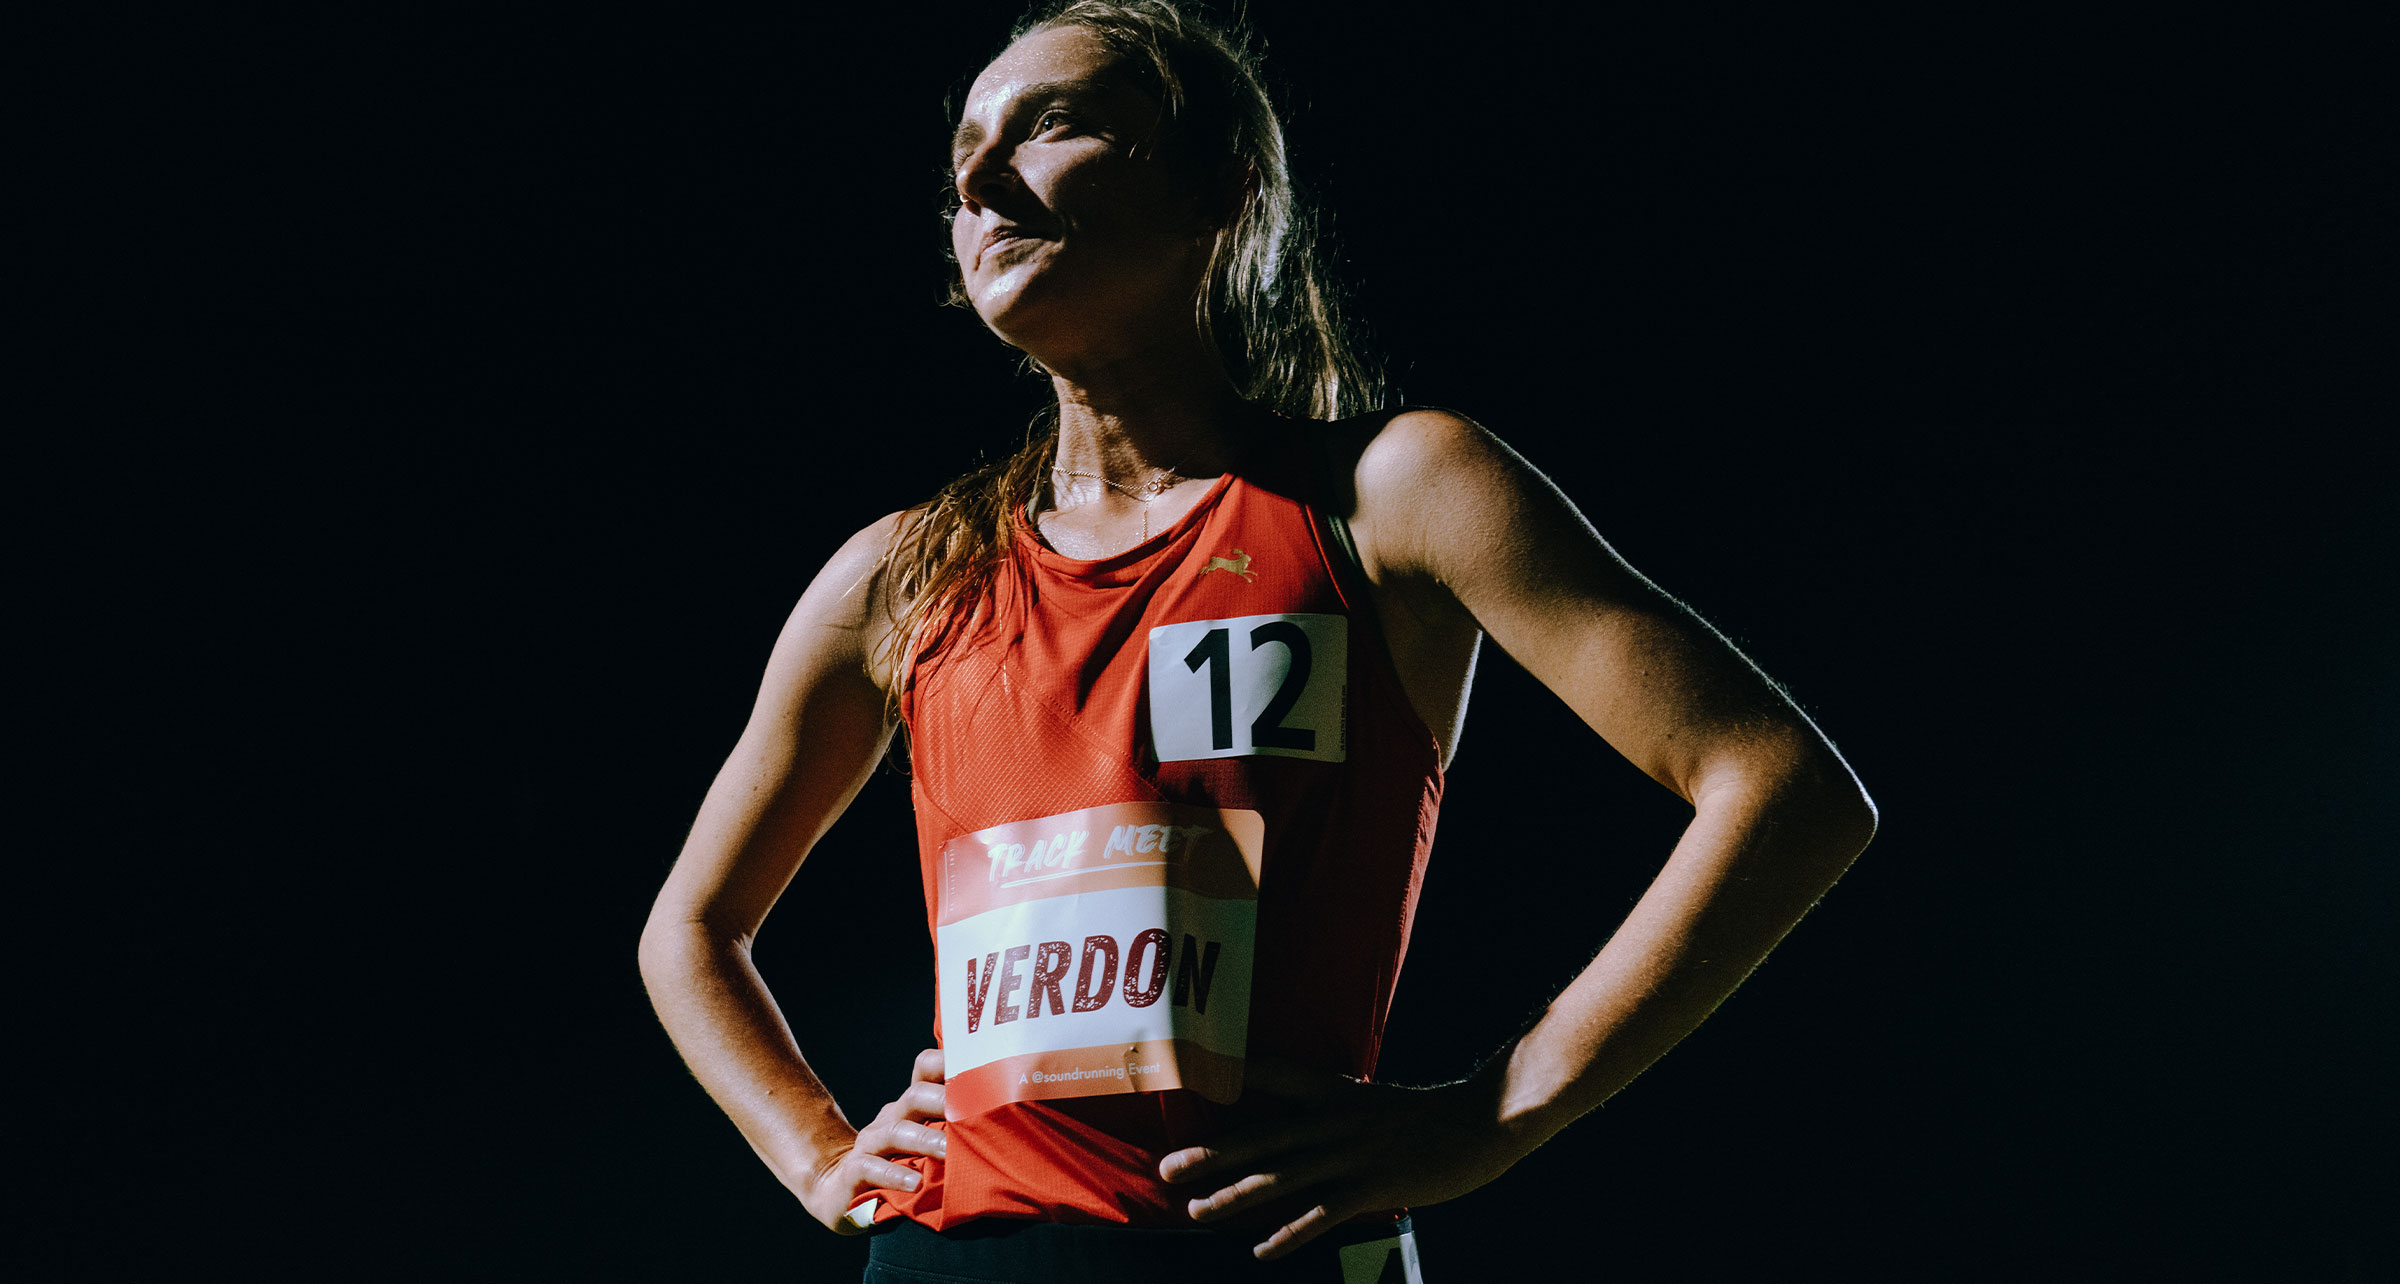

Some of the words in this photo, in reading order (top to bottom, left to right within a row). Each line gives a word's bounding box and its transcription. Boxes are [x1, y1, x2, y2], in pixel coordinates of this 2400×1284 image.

[1184, 621, 1316, 751] 12
[987, 830, 1090, 882] TRACK
[1104, 823, 1213, 860] MEET
[967, 928, 1221, 1034] VERDON
[1018, 1073, 1029, 1085] A
[1032, 1065, 1125, 1084] @soundrunning
[1128, 1062, 1160, 1076] Event
